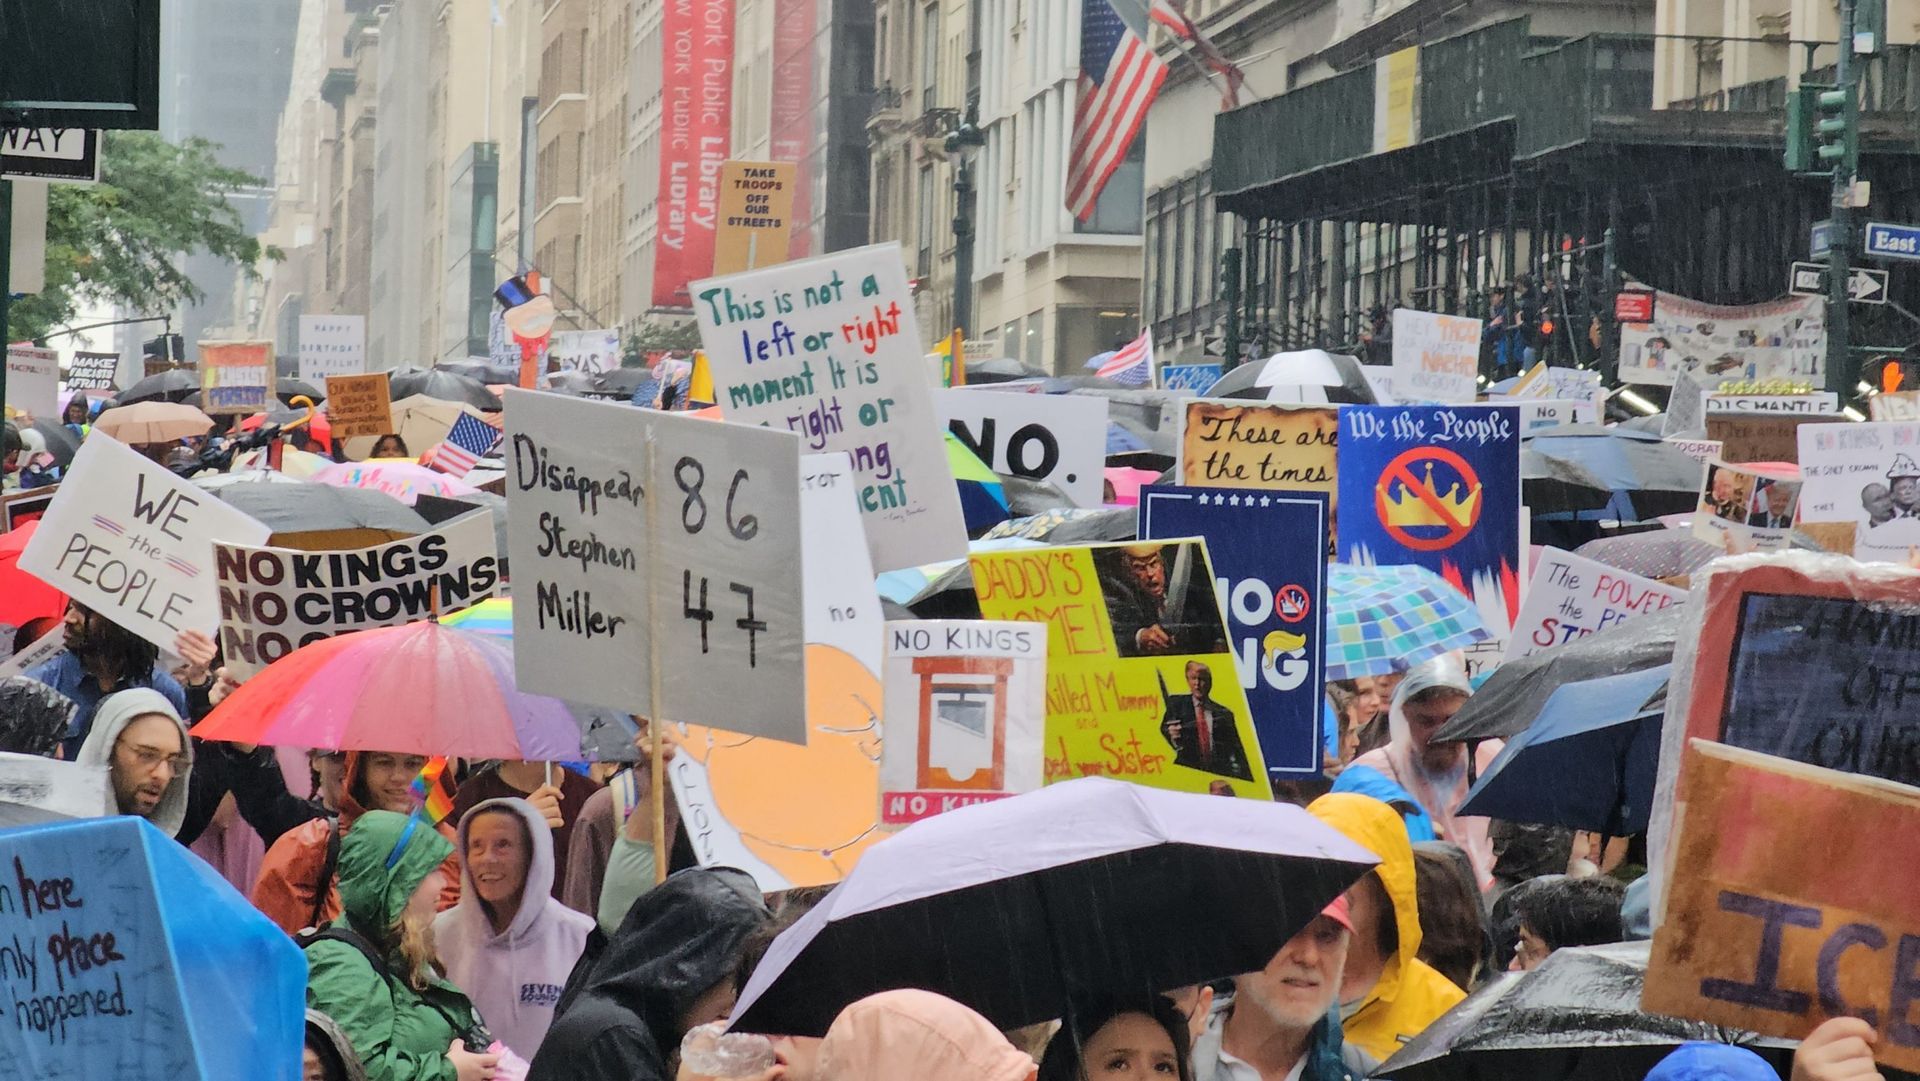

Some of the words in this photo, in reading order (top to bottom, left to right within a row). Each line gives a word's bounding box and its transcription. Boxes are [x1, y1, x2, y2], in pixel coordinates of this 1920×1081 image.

[702, 58, 727, 125] Public
[691, 136, 724, 231] Library
[734, 180, 783, 191] TROOPS
[744, 168, 776, 178] TAKE
[662, 161, 689, 251] Library
[728, 216, 782, 228] STREETS
[745, 205, 769, 215] OUR
[746, 194, 769, 204] OFF
[1874, 231, 1916, 252] East
[699, 287, 765, 326] This
[774, 289, 793, 315] is
[804, 270, 844, 308] not
[861, 274, 880, 298] a
[743, 320, 796, 364] left
[803, 331, 833, 351] or
[841, 301, 902, 355] right
[66, 378, 111, 389] AFRAID
[72, 357, 116, 368] MAKE
[728, 361, 815, 409] moment
[856, 360, 879, 385] is
[787, 396, 843, 450] right
[858, 397, 895, 427] or
[1200, 414, 1286, 445] These
[1295, 427, 1338, 447] are
[1346, 409, 1390, 442] We
[1390, 410, 1429, 442] the
[1429, 409, 1514, 447] People
[513, 433, 645, 516] Disappear
[948, 417, 1077, 484] NO.
[1203, 450, 1250, 481] the
[1257, 452, 1335, 483] times
[1805, 466, 1820, 477] THE
[133, 473, 200, 542] WE
[127, 534, 162, 561] the
[216, 545, 284, 586] NO
[292, 534, 449, 589] KINGS
[537, 512, 636, 572] Stephen
[56, 532, 193, 633] PEOPLE
[218, 586, 288, 626] NO
[294, 556, 497, 625] CROWNS
[969, 552, 1083, 600] DADDY'S
[1549, 562, 1581, 590] The
[536, 580, 625, 639] Miller
[1558, 596, 1583, 620] the
[221, 625, 293, 665] NO
[894, 628, 931, 651] NO
[945, 627, 1032, 653] KINGS
[1093, 671, 1159, 720] Mommy
[1099, 727, 1166, 776] Sister
[889, 795, 928, 817] NO
[47, 919, 125, 992] place
[12, 971, 133, 1045] happened.
